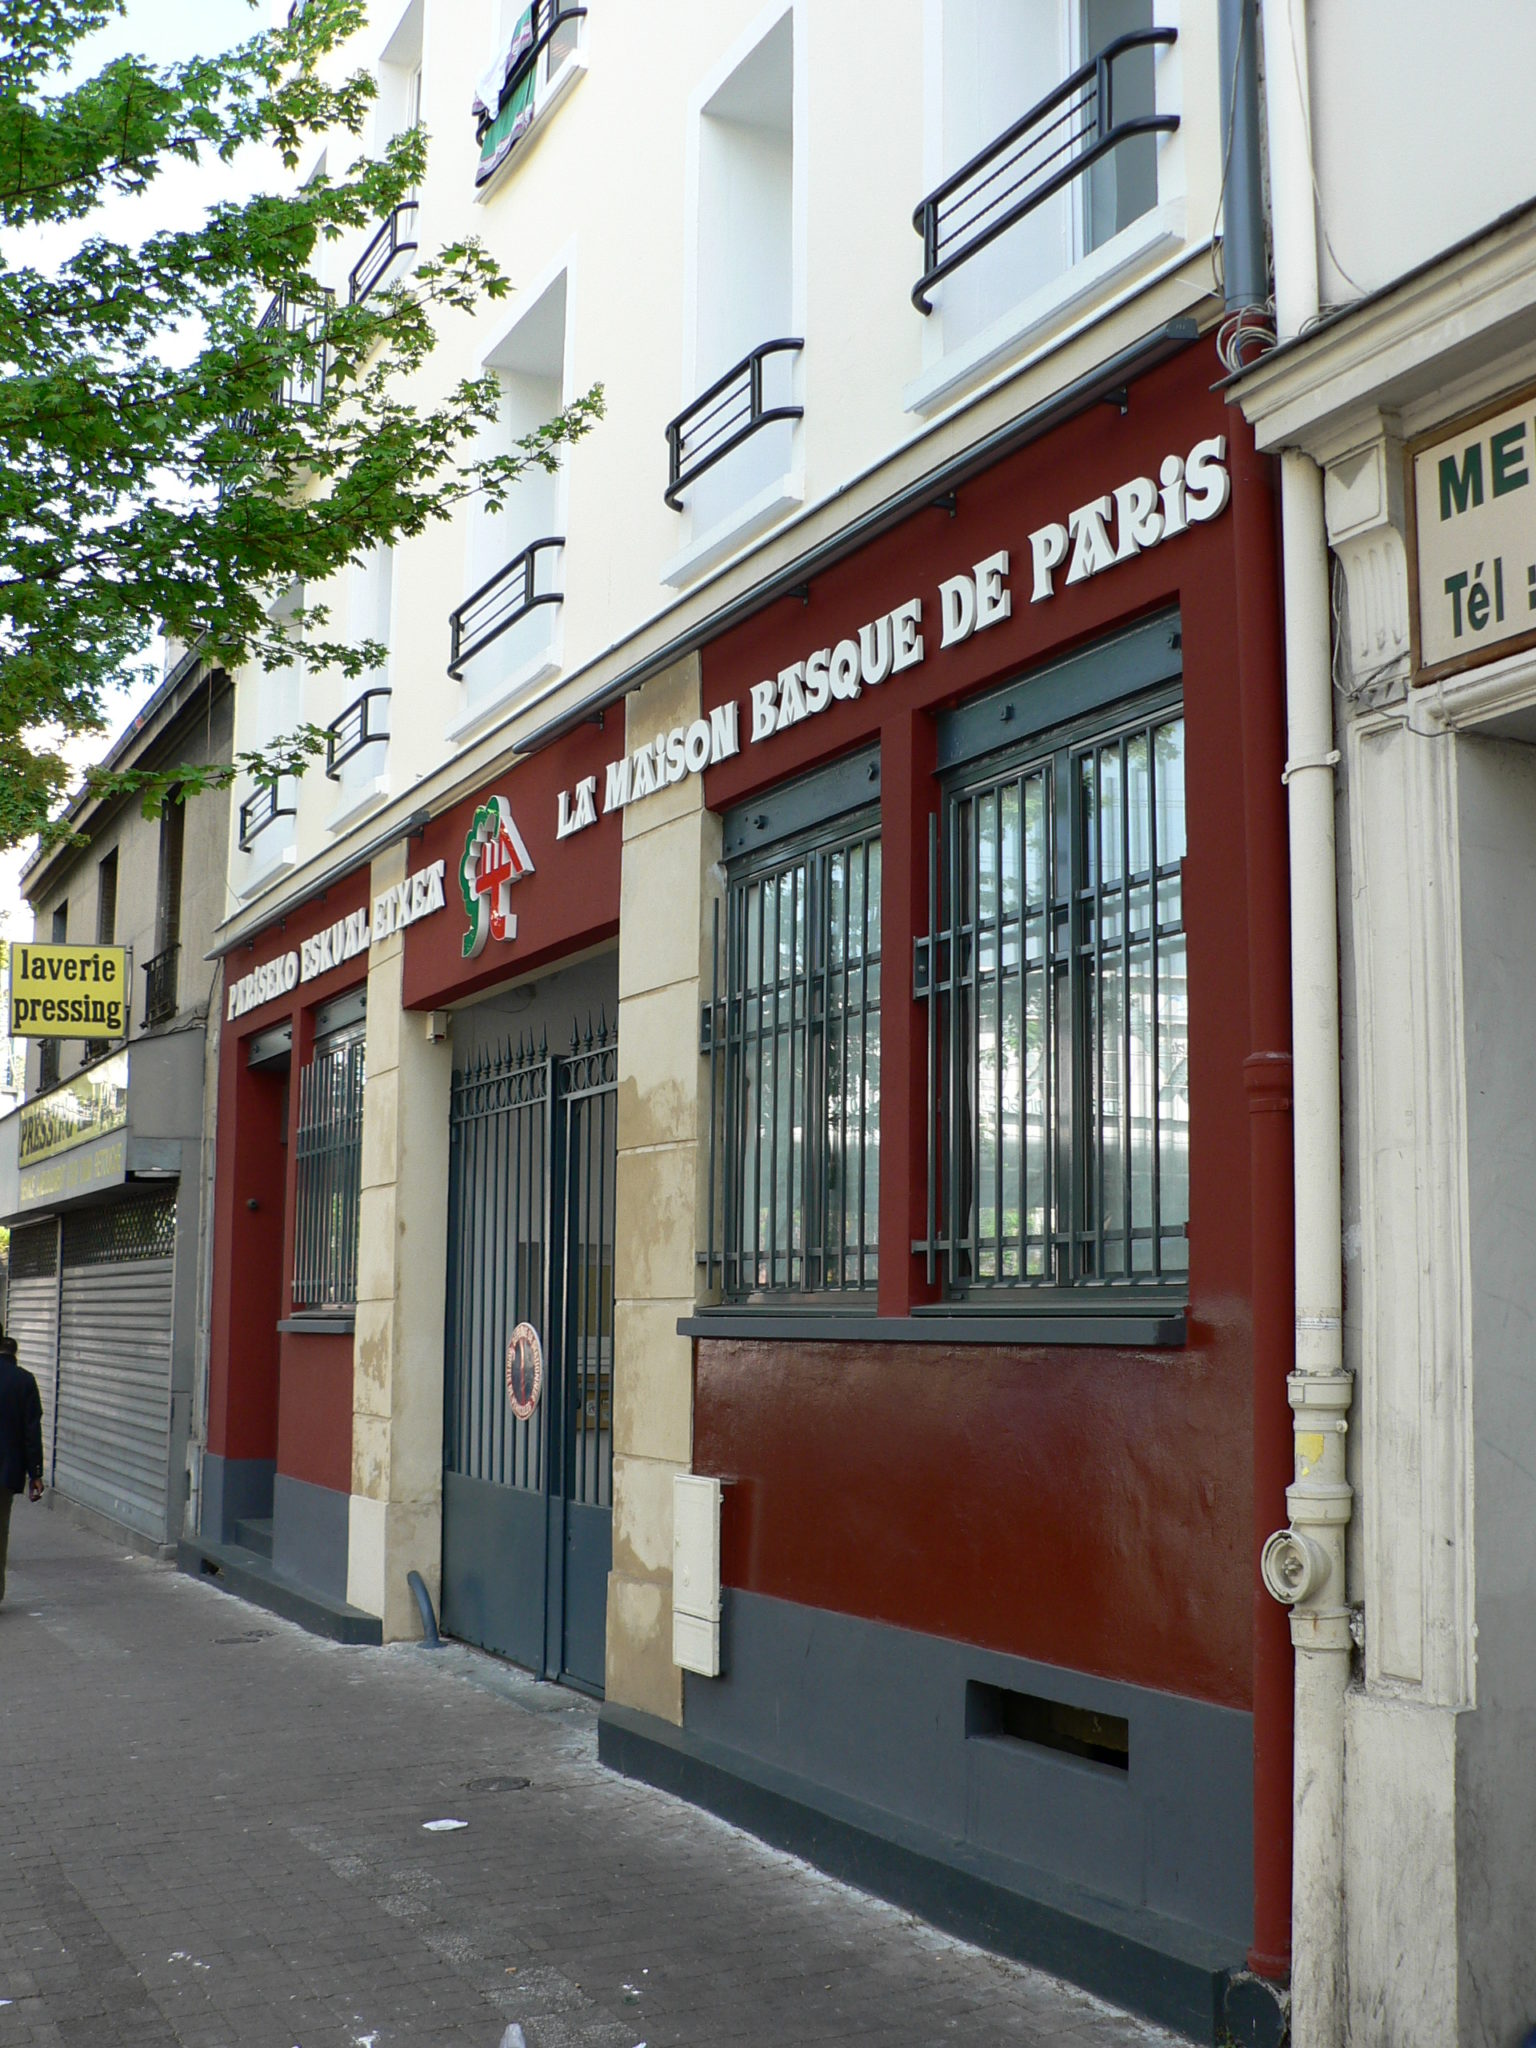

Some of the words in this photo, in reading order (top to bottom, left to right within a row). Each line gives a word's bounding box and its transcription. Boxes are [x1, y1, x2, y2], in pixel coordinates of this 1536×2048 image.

[1438, 416, 1536, 522] ME
[1445, 556, 1504, 638] Tél
[556, 775, 598, 840] LA
[750, 598, 924, 743] BASQUE
[938, 550, 1012, 649] DE
[21, 949, 116, 982] laverie
[301, 907, 371, 983] ESKUAL
[372, 859, 446, 943] ETXEA
[13, 994, 122, 1029] pressing
